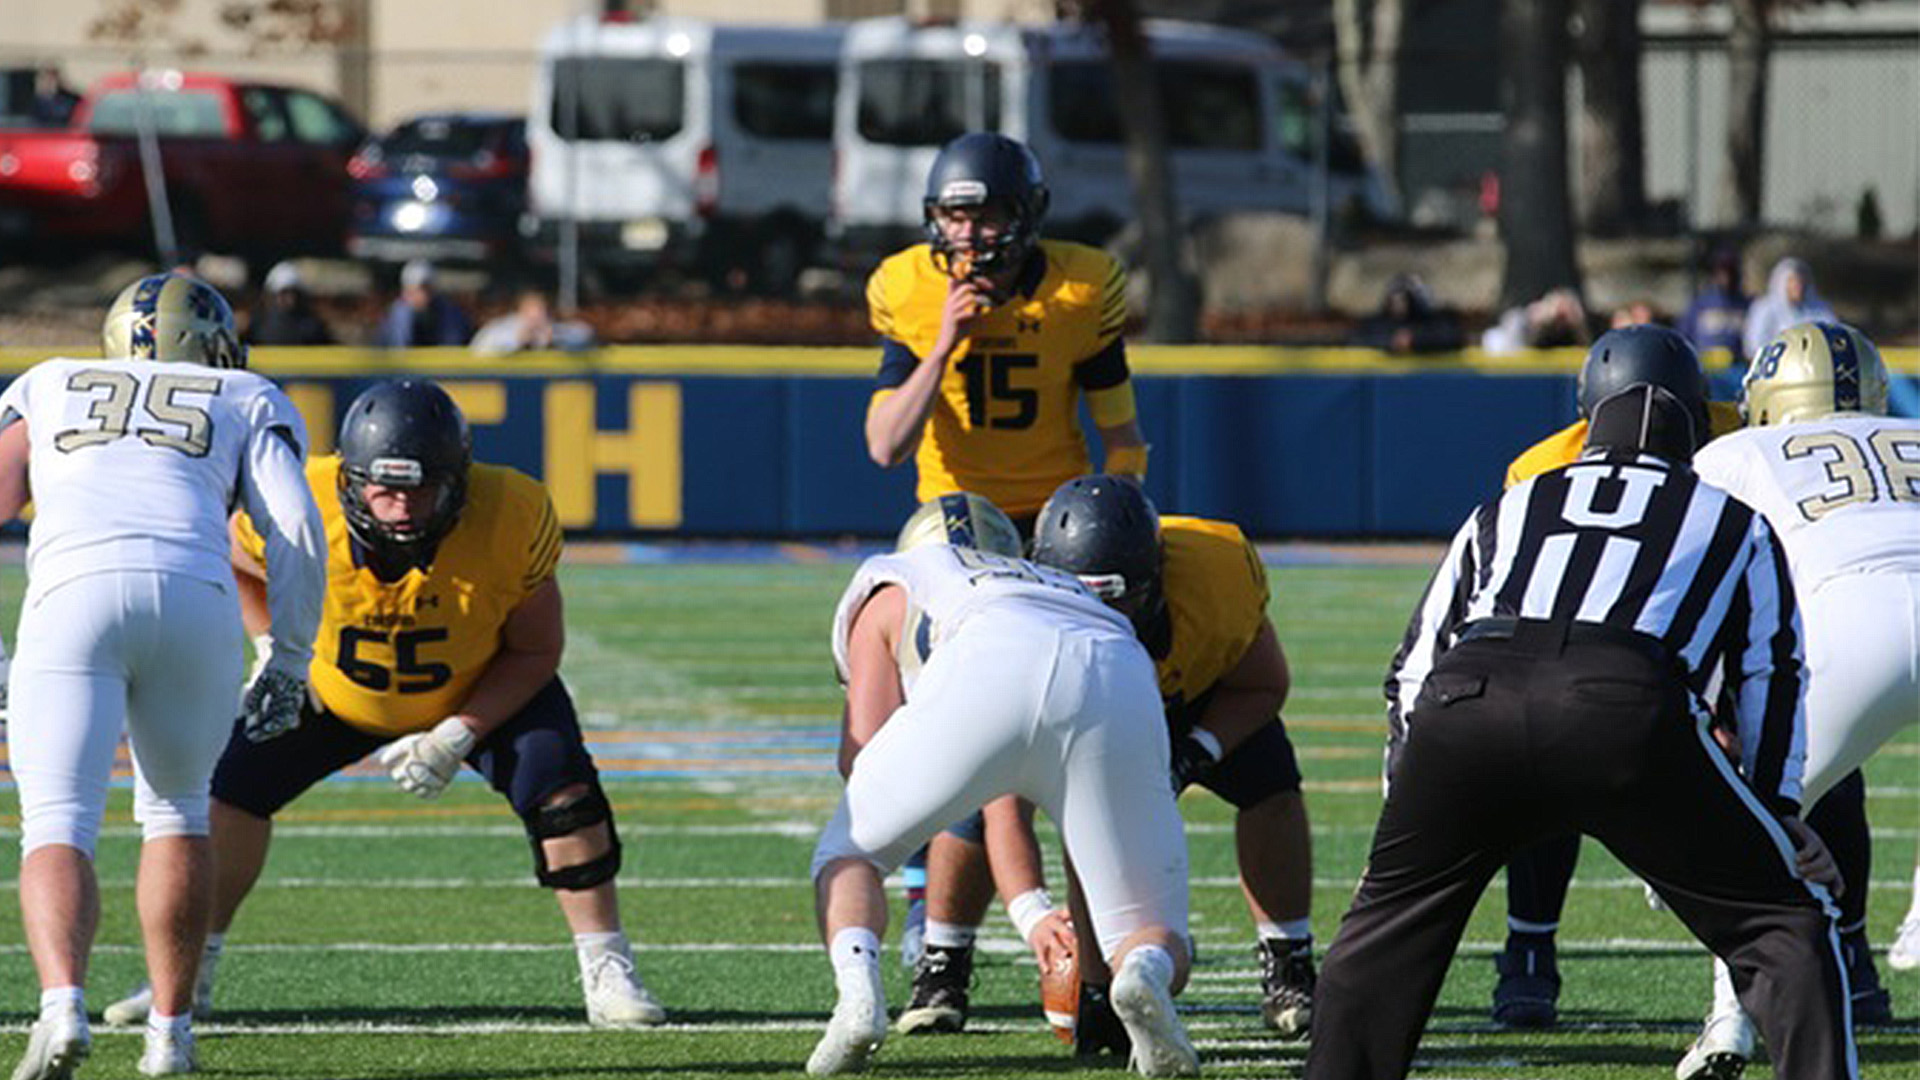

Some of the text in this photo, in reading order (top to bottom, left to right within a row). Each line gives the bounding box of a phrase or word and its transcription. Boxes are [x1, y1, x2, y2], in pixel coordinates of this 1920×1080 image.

[54, 369, 222, 458] 35
[955, 353, 1039, 429] 15
[1561, 465, 1668, 529] U
[337, 625, 452, 694] 65
